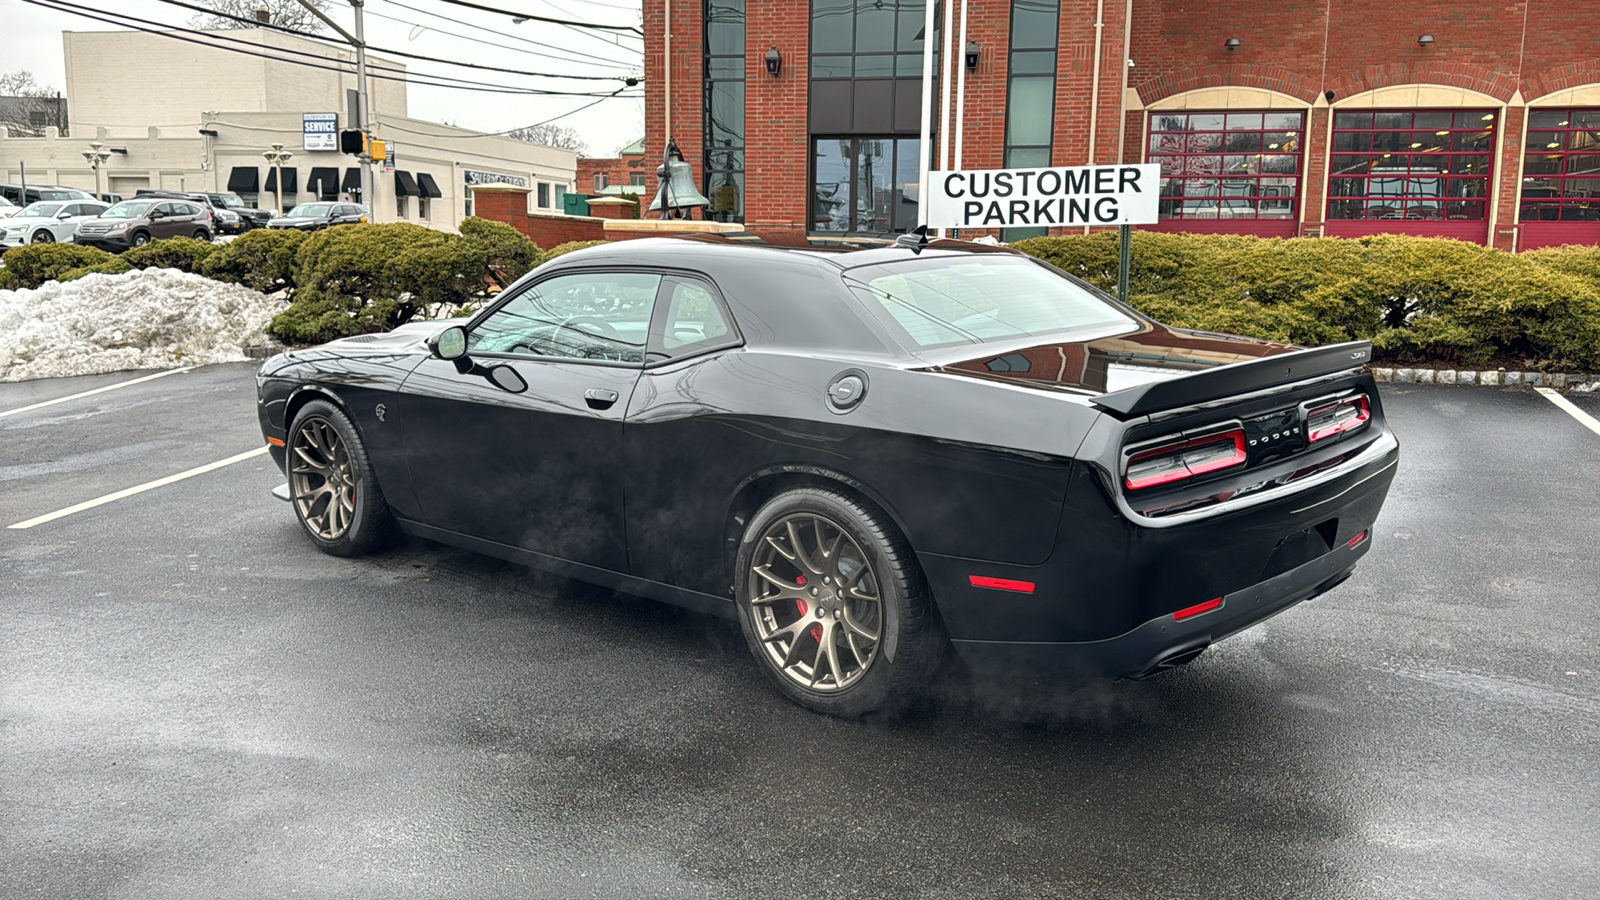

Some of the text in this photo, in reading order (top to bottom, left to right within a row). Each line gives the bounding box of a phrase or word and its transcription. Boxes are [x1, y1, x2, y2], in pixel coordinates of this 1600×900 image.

[304, 122, 335, 132] SERVICE
[944, 167, 1142, 198] CUSTOMER
[964, 196, 1119, 226] PARKING
[1249, 427, 1299, 446] DODGE
